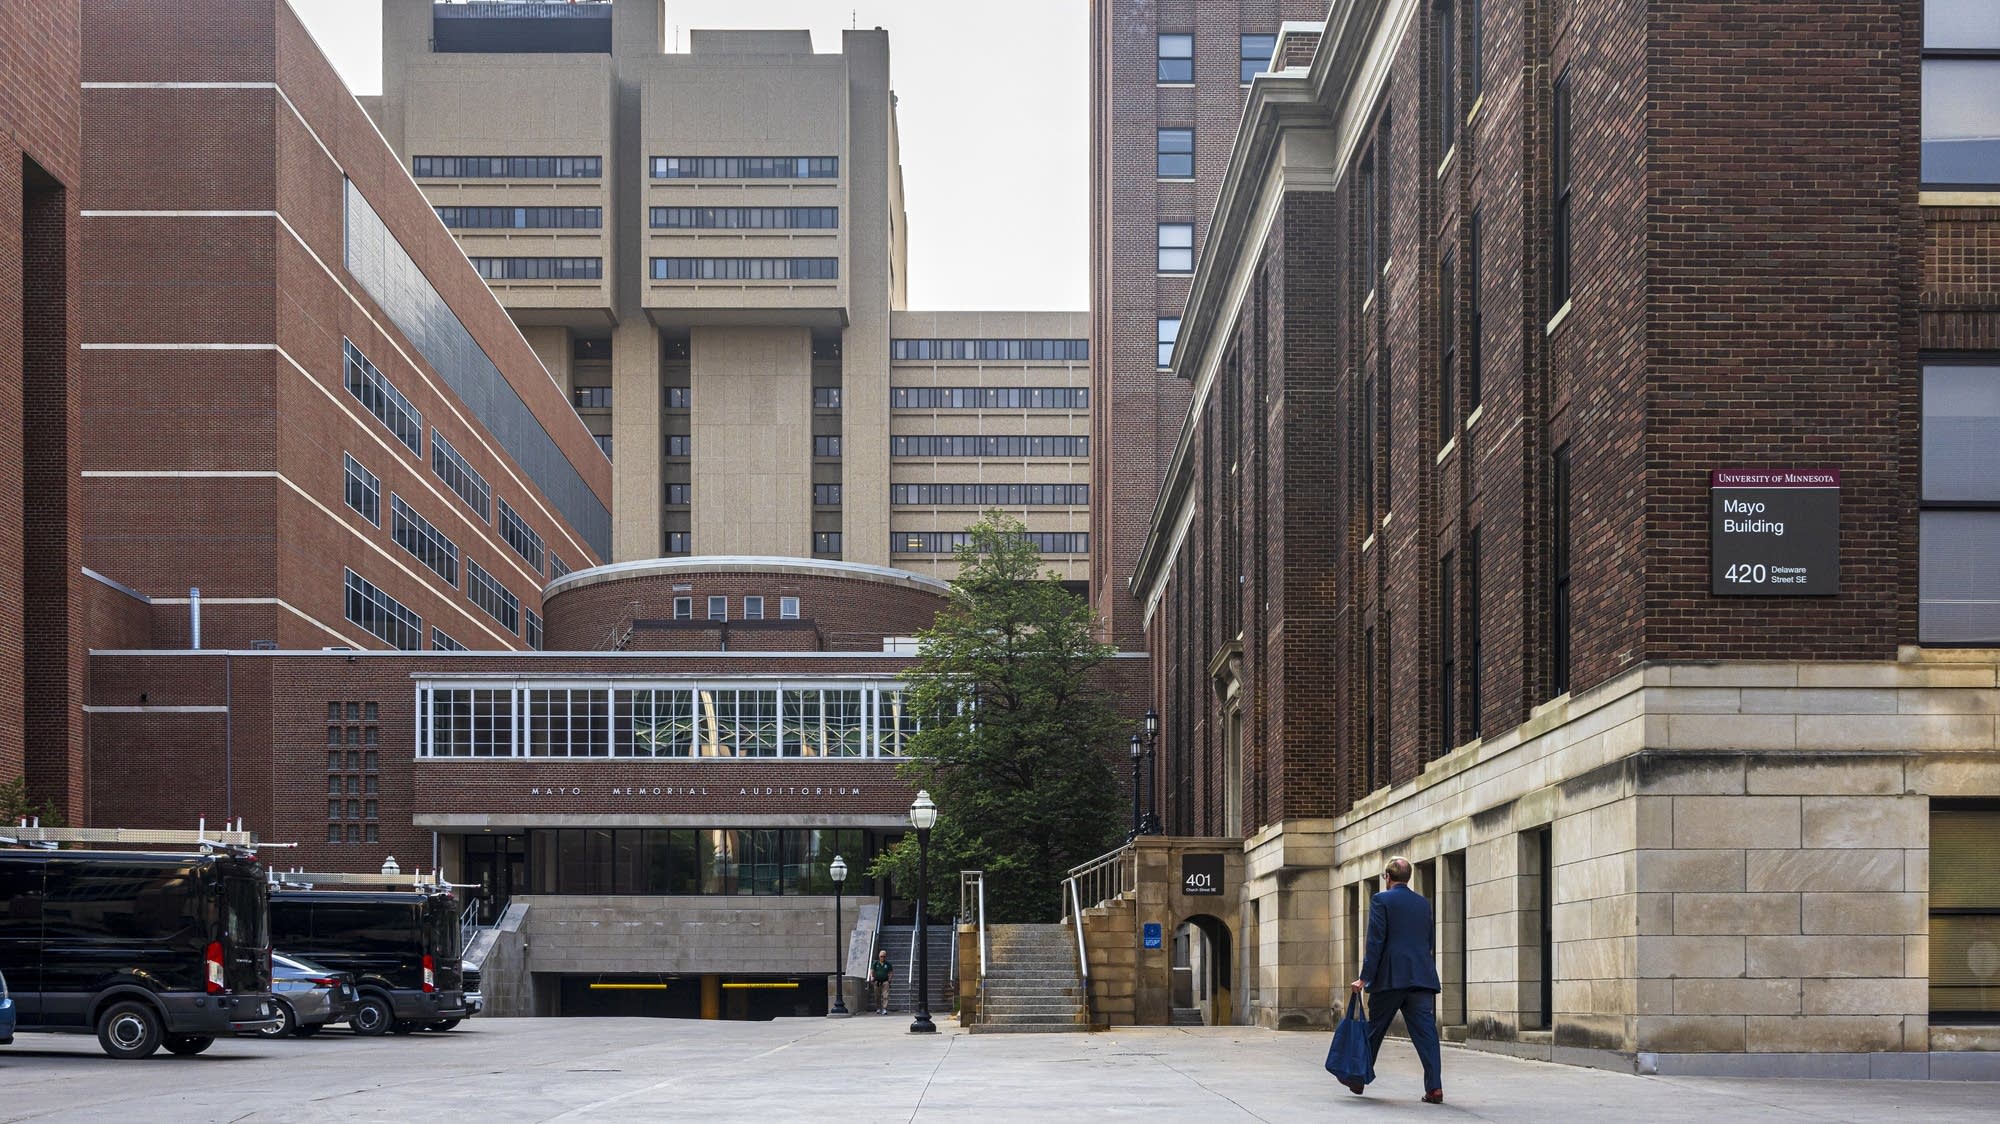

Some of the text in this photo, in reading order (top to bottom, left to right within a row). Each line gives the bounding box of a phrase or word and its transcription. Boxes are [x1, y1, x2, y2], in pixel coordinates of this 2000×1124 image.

[1718, 473, 1834, 483] UNIVERSITY OF MINNESOTA
[1724, 499, 1765, 516] Mayo
[1724, 519, 1784, 536] Building
[1724, 563, 1766, 583] 420
[1771, 566, 1807, 574] Delaware
[1771, 575, 1807, 584] Street SE
[531, 787, 862, 796] MAYO MEMORIAL AUDITORIUM
[1186, 873, 1211, 887] 401
